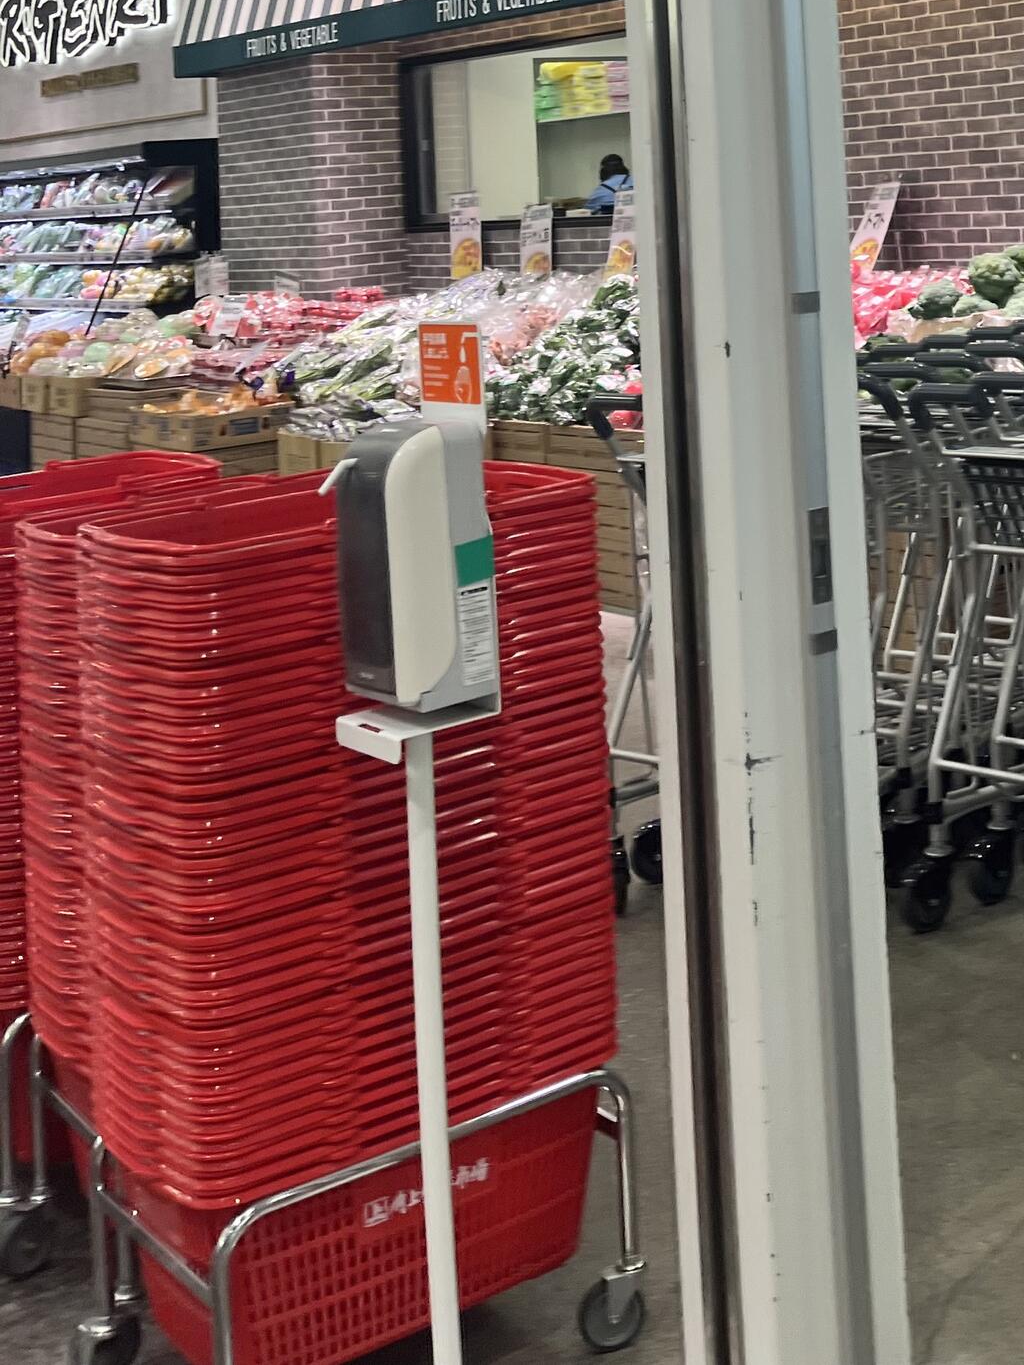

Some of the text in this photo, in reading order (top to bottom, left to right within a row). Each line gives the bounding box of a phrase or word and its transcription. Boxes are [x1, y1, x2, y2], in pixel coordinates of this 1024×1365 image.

[246, 21, 340, 58] FRUITS & VEGETABLE
